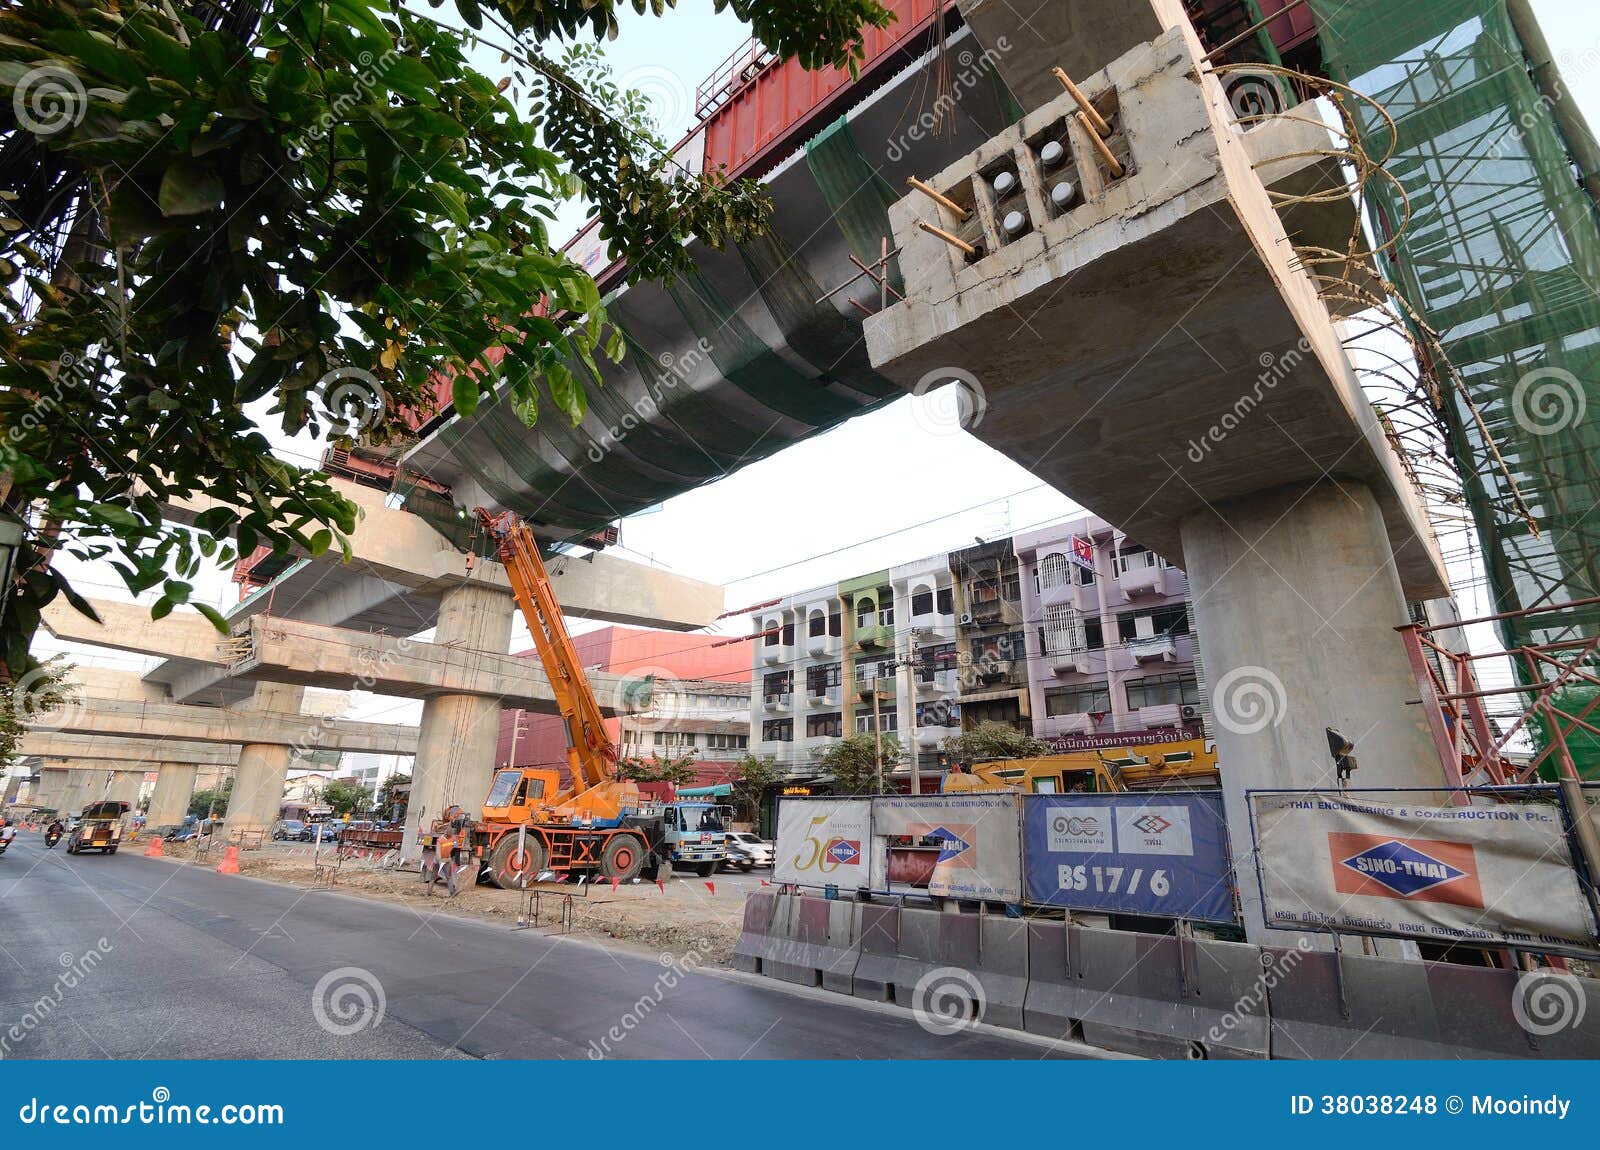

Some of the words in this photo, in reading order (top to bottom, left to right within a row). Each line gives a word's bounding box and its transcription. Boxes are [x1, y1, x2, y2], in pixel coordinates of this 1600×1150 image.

[1318, 801, 1394, 816] ENGINEERING
[1400, 809, 1408, 817] &
[1415, 810, 1519, 821] CONSTRUCTION
[1526, 812, 1553, 822] Plc.
[1058, 864, 1087, 891] BS
[1356, 856, 1448, 880] SINO-THAI
